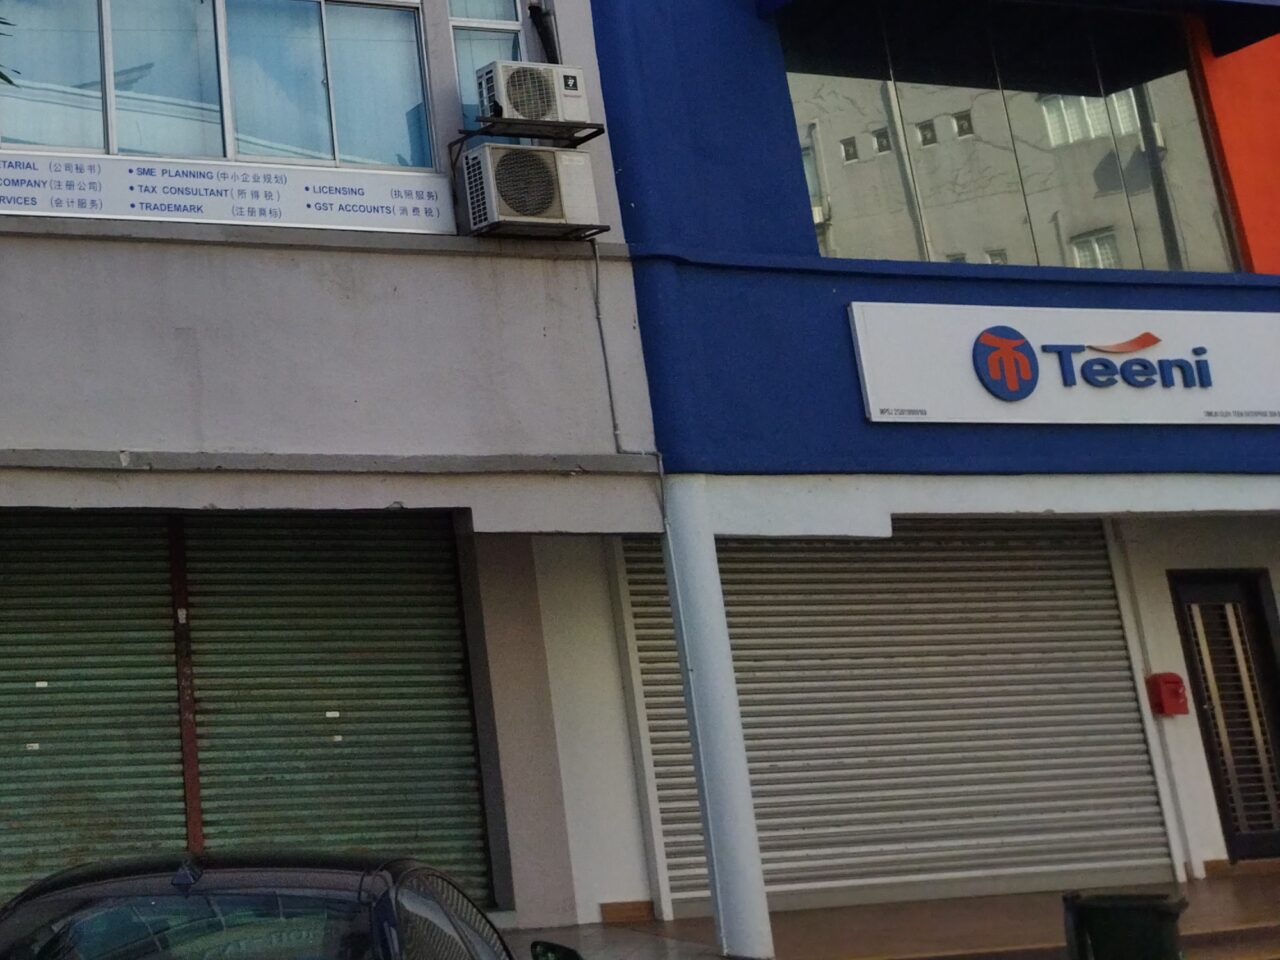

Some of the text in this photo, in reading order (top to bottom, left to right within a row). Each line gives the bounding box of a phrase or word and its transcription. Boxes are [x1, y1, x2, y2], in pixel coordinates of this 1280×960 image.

[136, 168, 156, 176] SME
[161, 169, 214, 180] PLANNING
[137, 185, 157, 194] TAX
[162, 186, 229, 198] CONSULTANT
[312, 186, 365, 196] LICENSING
[139, 202, 204, 214] TRADEMARK
[314, 203, 334, 211] GST
[338, 204, 391, 215] ACCOUNTS
[1041, 344, 1213, 388] Teeni
